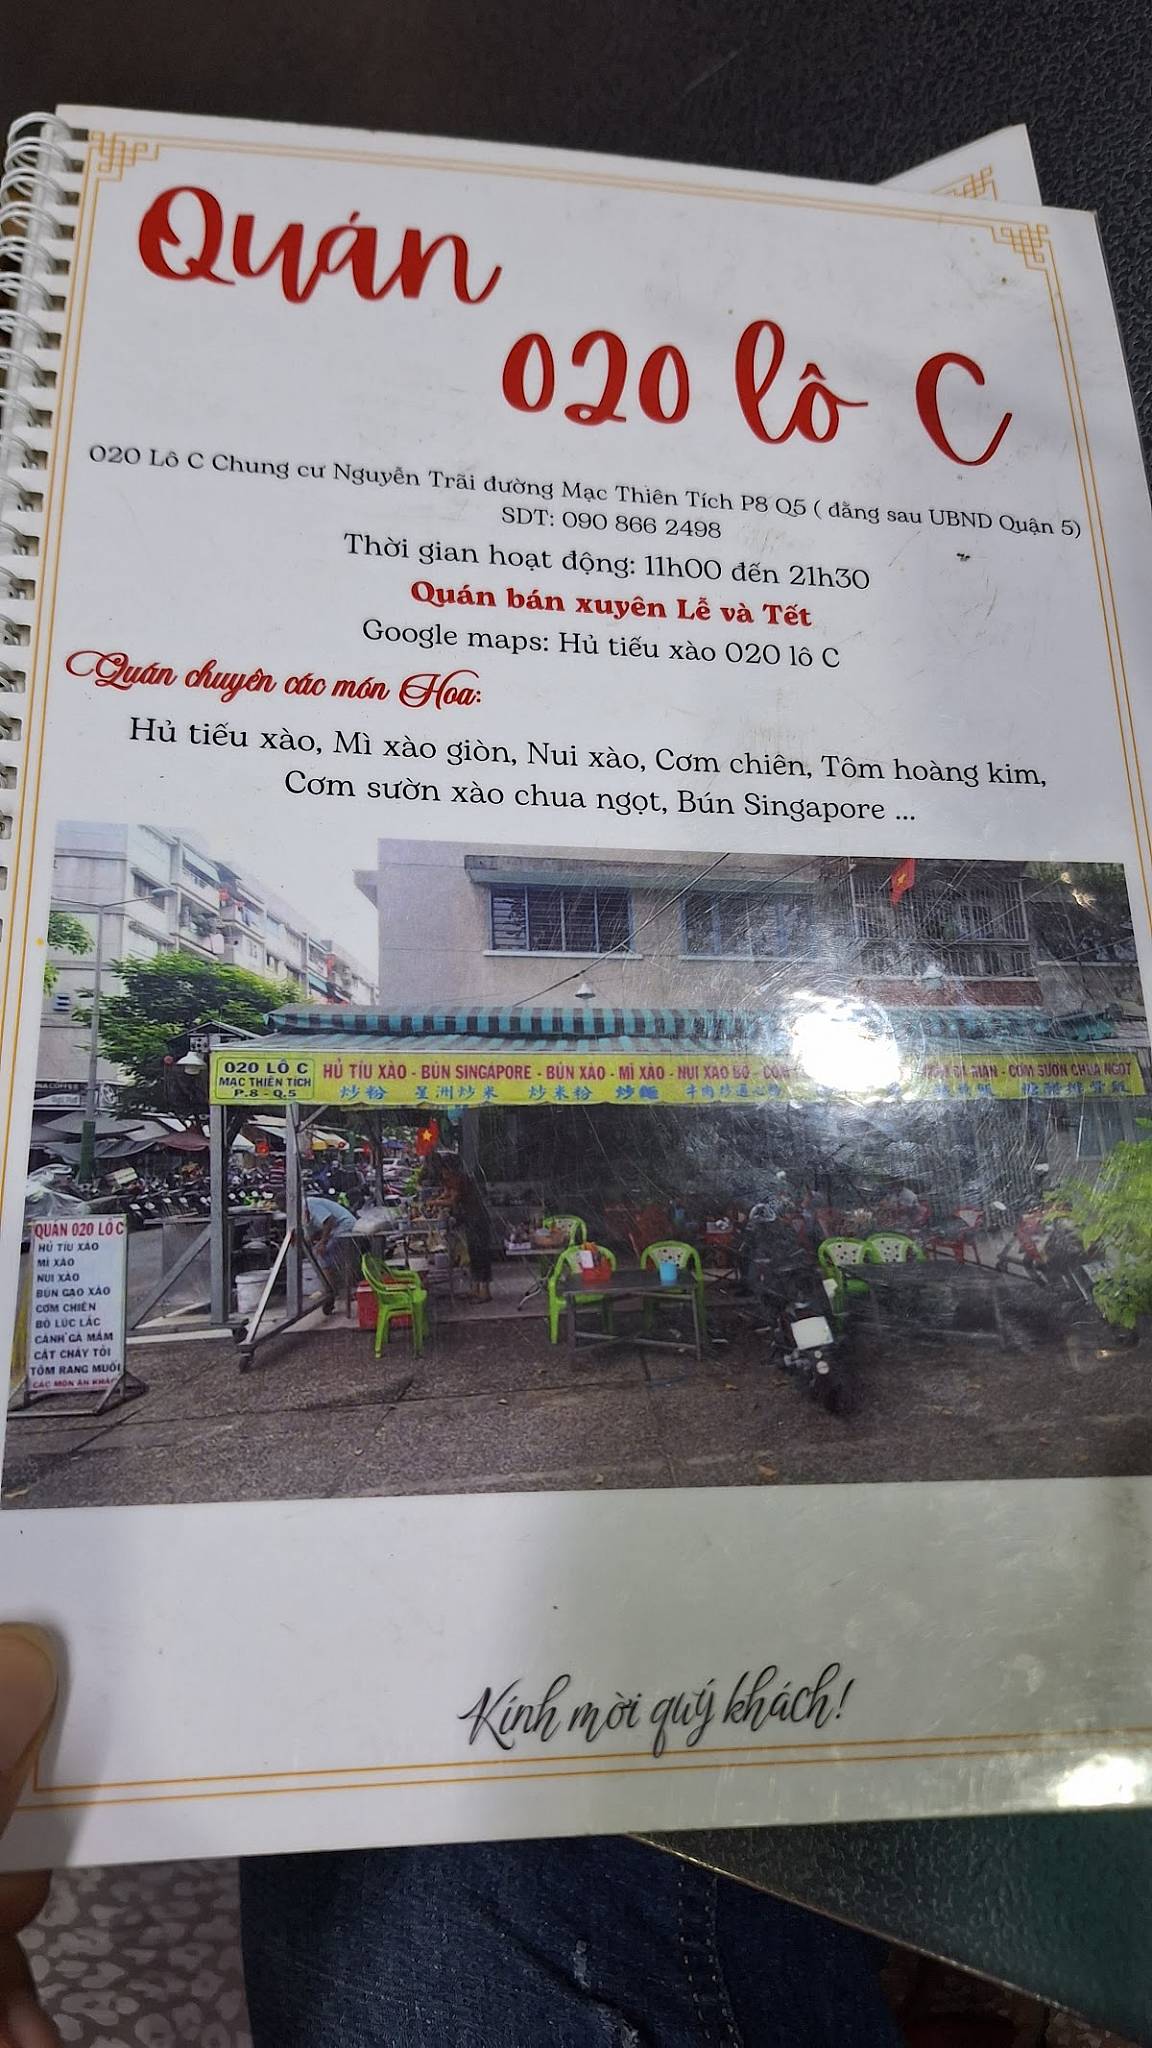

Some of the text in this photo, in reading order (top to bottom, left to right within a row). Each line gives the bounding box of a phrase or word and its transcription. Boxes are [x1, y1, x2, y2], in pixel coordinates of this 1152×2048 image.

[138, 186, 502, 304] Quán
[502, 320, 1012, 466] 020 lô C
[90, 445, 140, 464] 020
[150, 449, 179, 467] Lô
[188, 453, 203, 469] C
[213, 454, 288, 479] Chung
[298, 466, 325, 478] cư
[334, 463, 420, 487] Nguyễn
[429, 470, 475, 490] Trãi
[484, 476, 553, 499] đường
[563, 482, 606, 502] Mạc
[615, 486, 677, 505] Thiên
[686, 491, 732, 509] Tích
[742, 495, 768, 512] P8
[776, 498, 806, 517] Q5
[829, 501, 879, 524] đằng
[887, 511, 921, 523] sau
[929, 509, 992, 528] UBND
[999, 515, 1054, 535] Quận
[1062, 520, 1080, 538] 5)
[502, 507, 721, 538] SDT: 090 866 2498
[344, 533, 869, 589] Thời gian hoạt động: 11h00 đến 21h30
[411, 581, 812, 626] Quán bán xuyên Lễ và Tết
[363, 619, 839, 667] Google maps: Hủ tiếu xào 020 lô C
[66, 651, 480, 709] Quán chuyên các món Hoa:
[130, 717, 1046, 787] Hủ tiếu xào, Mì xào giòn, Nui xào, Cơm chiên, Tôm hoàng kim,
[285, 770, 355, 796] Cơm
[368, 778, 440, 801] sườn
[451, 781, 503, 804] xào
[515, 784, 586, 808] chua
[597, 792, 667, 815] ngọt,
[677, 790, 734, 814] Bún
[745, 793, 885, 822] Singapore
[225, 1059, 308, 1074] 020 LÔ C
[323, 1058, 342, 1079] HỦ
[350, 1060, 373, 1079] TÍU
[378, 1060, 406, 1079] XÀO
[422, 1061, 450, 1079] BÚN
[546, 1062, 574, 1080] BÚN
[580, 1062, 605, 1080] XÀO
[619, 1062, 634, 1080] MÌ
[640, 1062, 665, 1080] XÀO
[234, 1089, 258, 1097] P.8
[273, 1089, 296, 1099] Q.5
[72, 1222, 94, 1236] 020
[116, 1222, 124, 1235] C
[457, 1661, 856, 1759] Kính mời quý khách!
